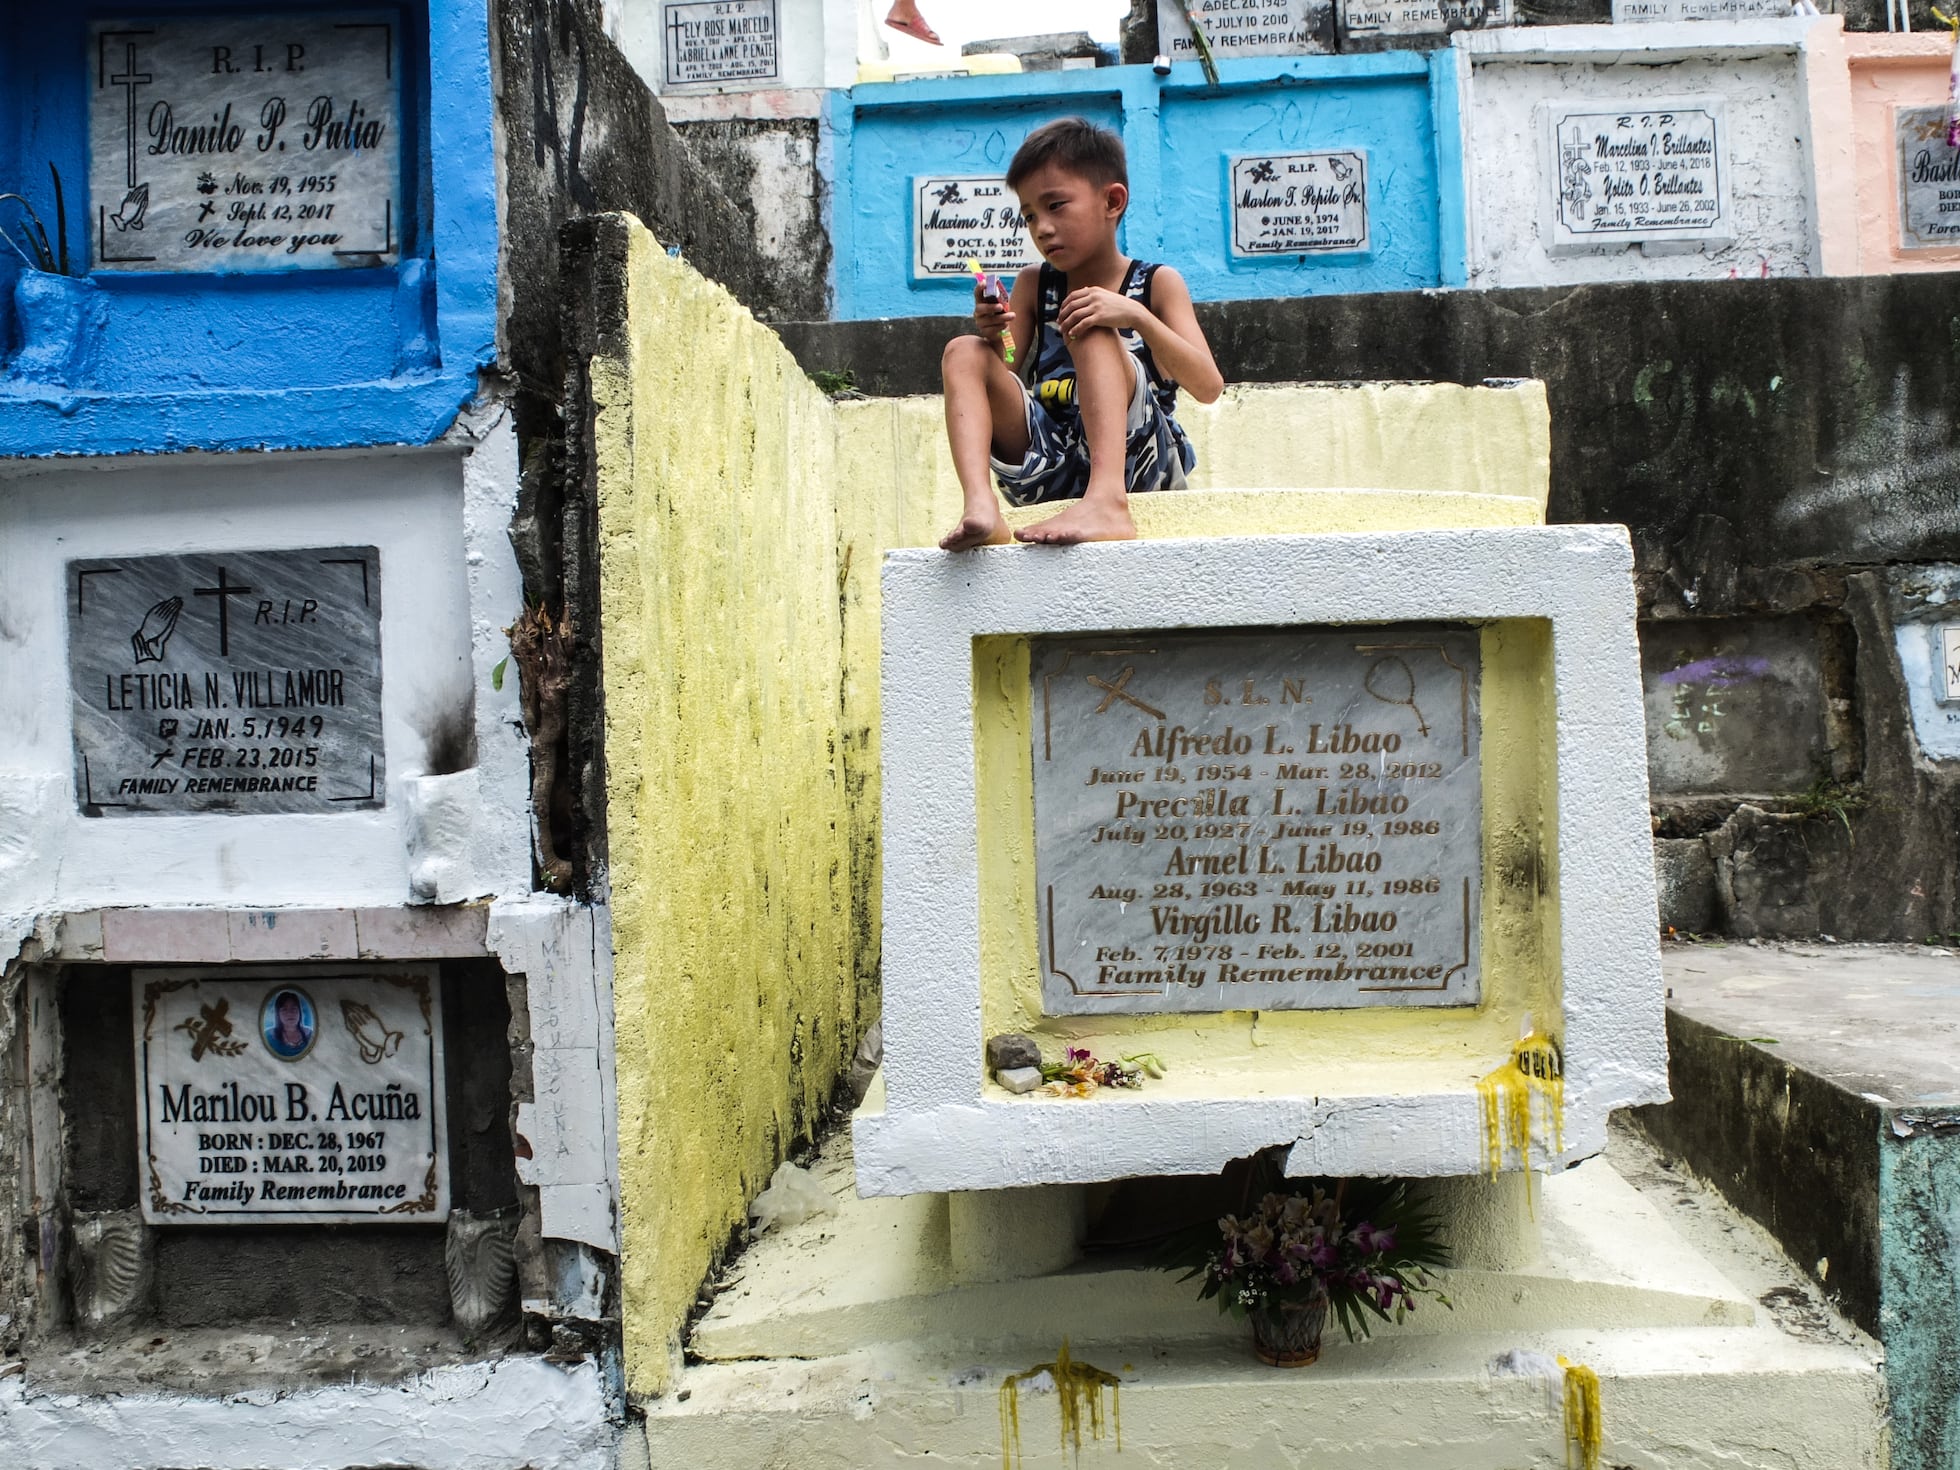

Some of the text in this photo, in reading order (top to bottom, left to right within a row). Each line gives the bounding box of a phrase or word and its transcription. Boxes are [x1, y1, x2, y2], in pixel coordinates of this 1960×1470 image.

[1350, 6, 1501, 24] FAMILY REMEMBRANCE
[1624, 4, 1668, 16] FAMILY
[684, 16, 769, 38] ELY ROSE MARCELO
[1216, 14, 1288, 28] JULY 10 2010
[720, 45, 739, 59] ANNE
[1174, 36, 1216, 51] FAMY
[687, 68, 767, 80] FAMILY REMEMBRANCE
[148, 100, 246, 155] Danilo
[257, 96, 286, 152] P.
[1595, 134, 1648, 158] Marcelina
[1662, 132, 1712, 156] Brillantes
[1288, 163, 1318, 174] R.I.P.
[1594, 161, 1612, 172] Feb.
[1616, 161, 1628, 173] 12,
[1658, 158, 1678, 170] June
[1680, 158, 1688, 171] 4,
[1912, 150, 1960, 183] Basil
[224, 172, 337, 198] Nov. 19, 1955
[974, 187, 1002, 197] R.I.P.
[1654, 172, 1703, 196] Brillantes
[1238, 188, 1283, 209] Marlon
[1594, 200, 1715, 216] Jan. 15, 1933 June 26, 2002
[1940, 202, 1960, 213] DIE
[272, 204, 292, 222] 12,
[297, 204, 335, 220] 2017
[1272, 214, 1339, 226] JUNE 9, 1974
[1592, 216, 1709, 230] Family Remembrance
[185, 228, 343, 254] We love you
[1272, 228, 1296, 237] JAN.
[1317, 226, 1340, 234] 2017
[957, 238, 1024, 248] OCT. 6, 1967
[1248, 238, 1357, 250] Family Remembrance
[957, 250, 982, 258] JAN.
[1001, 249, 1024, 258] 2017
[932, 261, 968, 272] Family
[107, 669, 345, 711] LETICIA N. VILLAMOR
[189, 717, 236, 740] JAN.
[1130, 723, 1402, 763] Alfredo L. Libao
[1084, 761, 1443, 787] June 19, 1954 Mar. 28, 2012
[118, 776, 318, 795] FAMILY REMEMBRANCE
[1271, 786, 1302, 817] L.
[1315, 786, 1409, 817] Libao
[1091, 824, 1146, 846] July
[1271, 822, 1333, 841] June
[1340, 821, 1374, 840] 19,
[1383, 820, 1440, 837] 1986
[1163, 842, 1382, 877] Arnel L. Libao
[1088, 879, 1441, 902] Aug. 28, 1963 May 11, 1986
[1270, 903, 1301, 935] R.
[1312, 901, 1398, 934] Libao
[1095, 945, 1143, 963] Feb.
[1256, 943, 1306, 960] Feb.
[1313, 942, 1350, 961] 12,
[1355, 941, 1413, 959] 2001
[1096, 960, 1443, 989] Family Remembrance
[160, 1081, 421, 1123] Marilou B. Acuña
[198, 1131, 385, 1151] BORN DEC. 28, 1967
[199, 1154, 386, 1174] DIED MAR. 20, 2019
[183, 1180, 406, 1206] Family Remembrance
